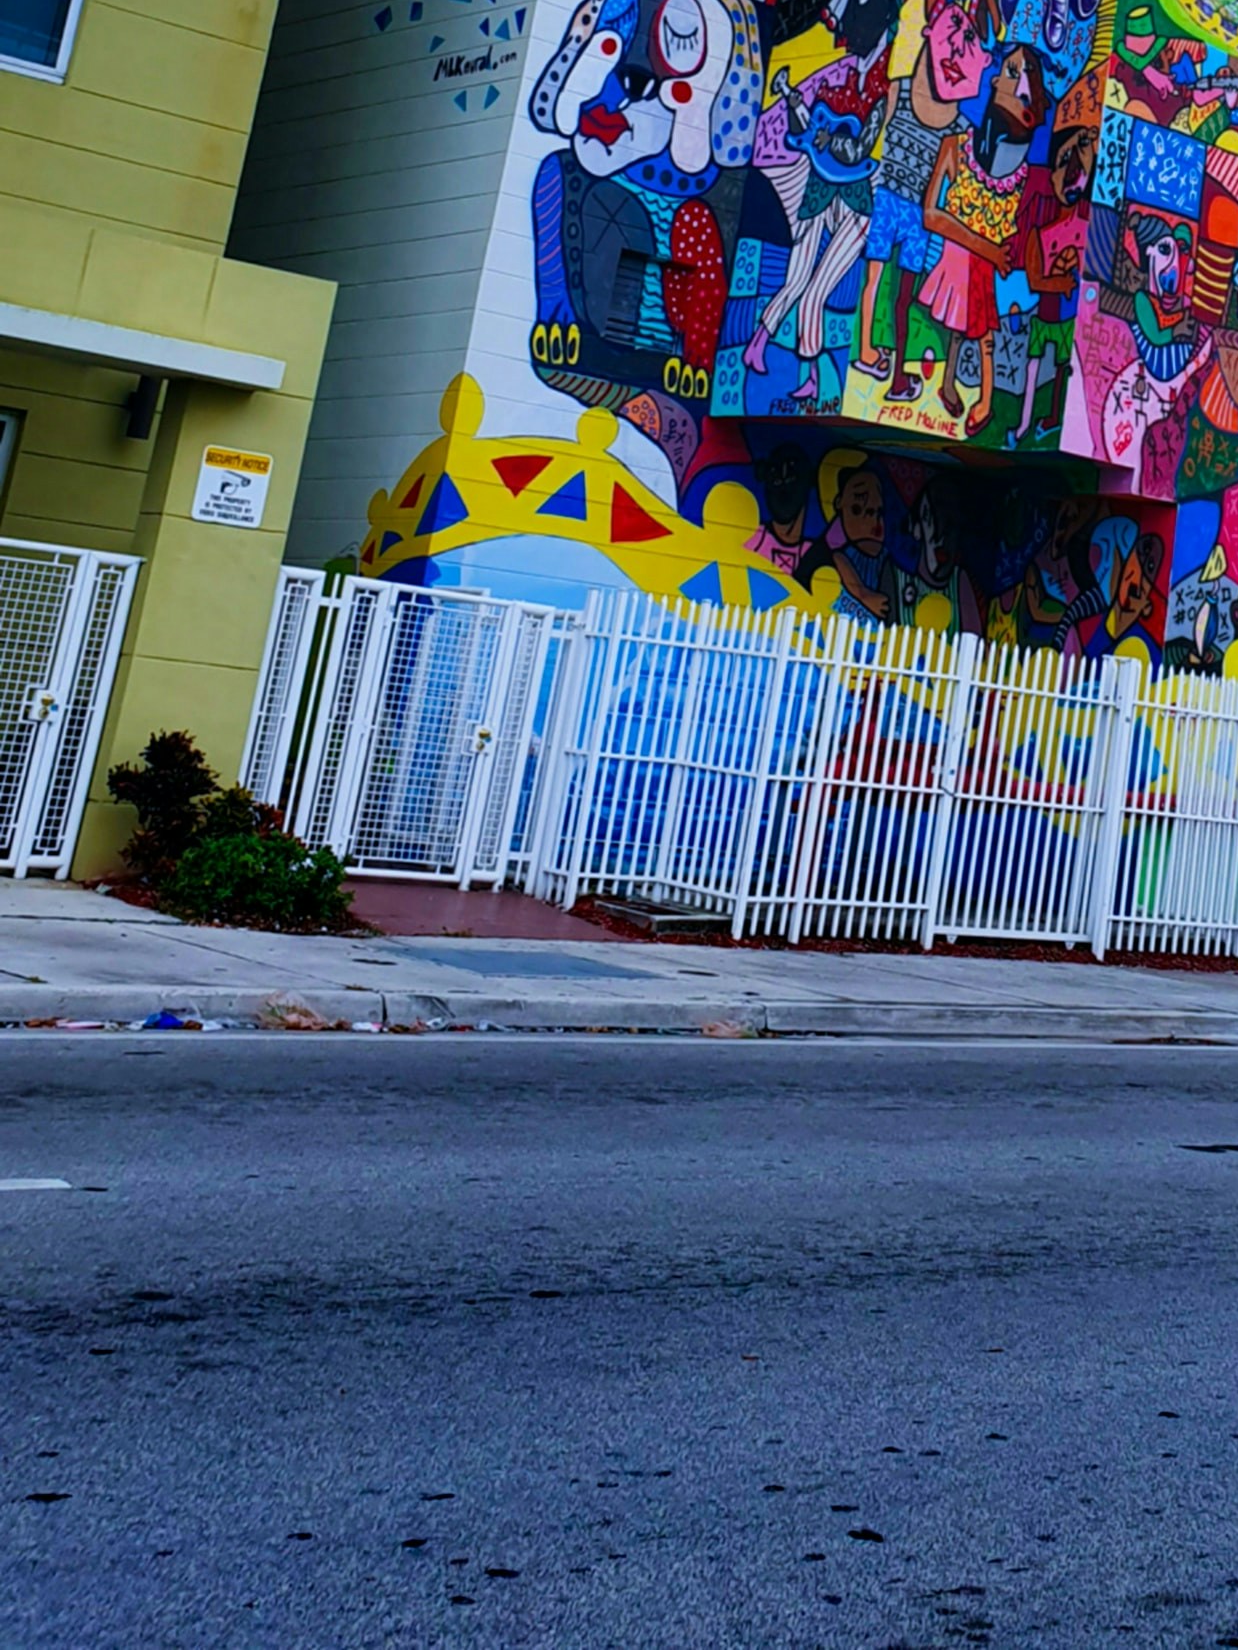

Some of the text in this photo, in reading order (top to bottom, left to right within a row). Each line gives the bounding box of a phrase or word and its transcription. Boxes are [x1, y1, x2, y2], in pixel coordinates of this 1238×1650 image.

[877, 405, 913, 425] FRED
[205, 451, 270, 473] SECURITY NOTICE
